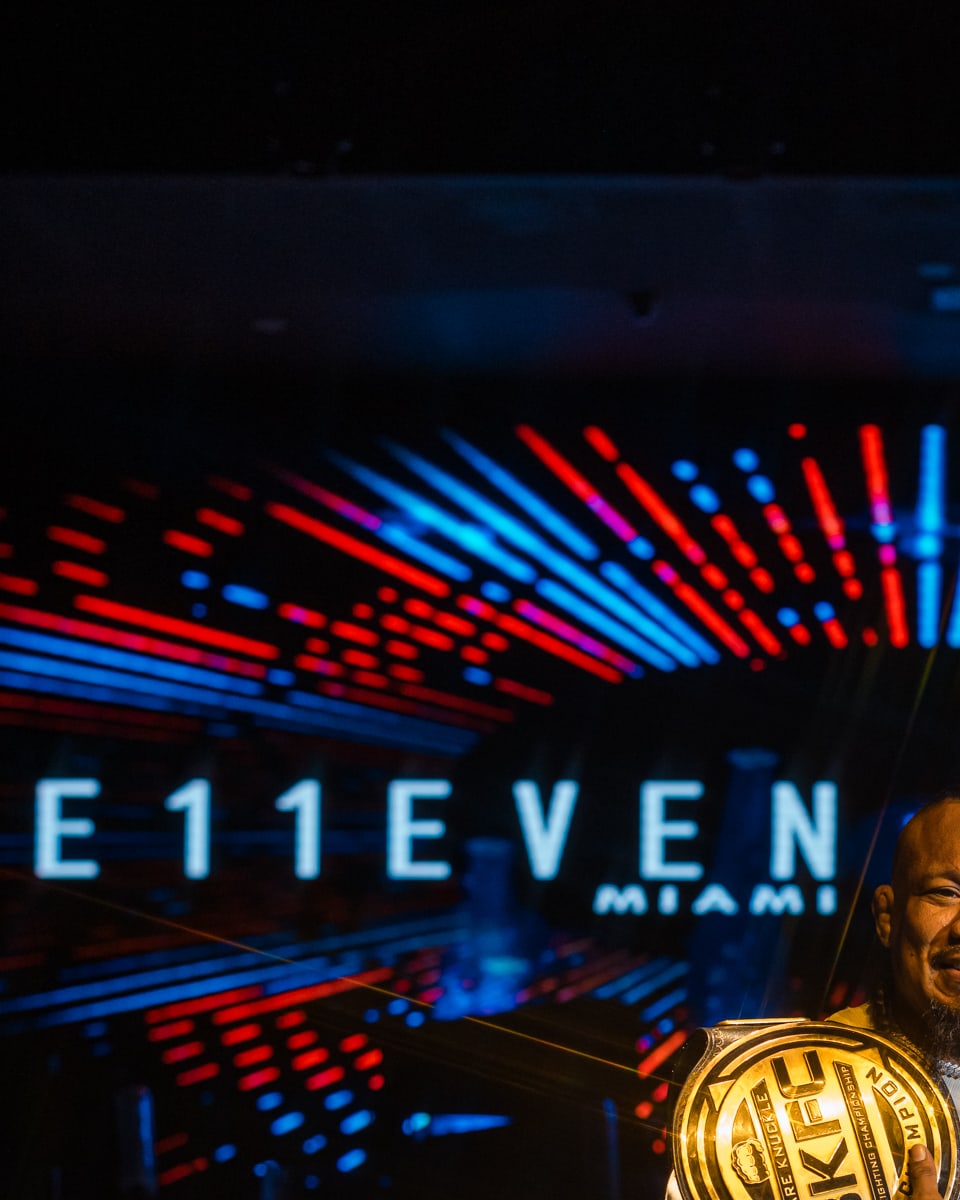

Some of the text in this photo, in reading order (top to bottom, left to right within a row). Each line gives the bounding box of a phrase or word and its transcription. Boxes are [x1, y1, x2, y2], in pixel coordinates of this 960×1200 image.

[34, 778, 839, 880] E11EVEN
[593, 884, 838, 916] MIAMI
[757, 1091, 788, 1170] KNUCKLE
[839, 1064, 873, 1149] CHAMPIONSHIP
[865, 1066, 921, 1197] CMPION
